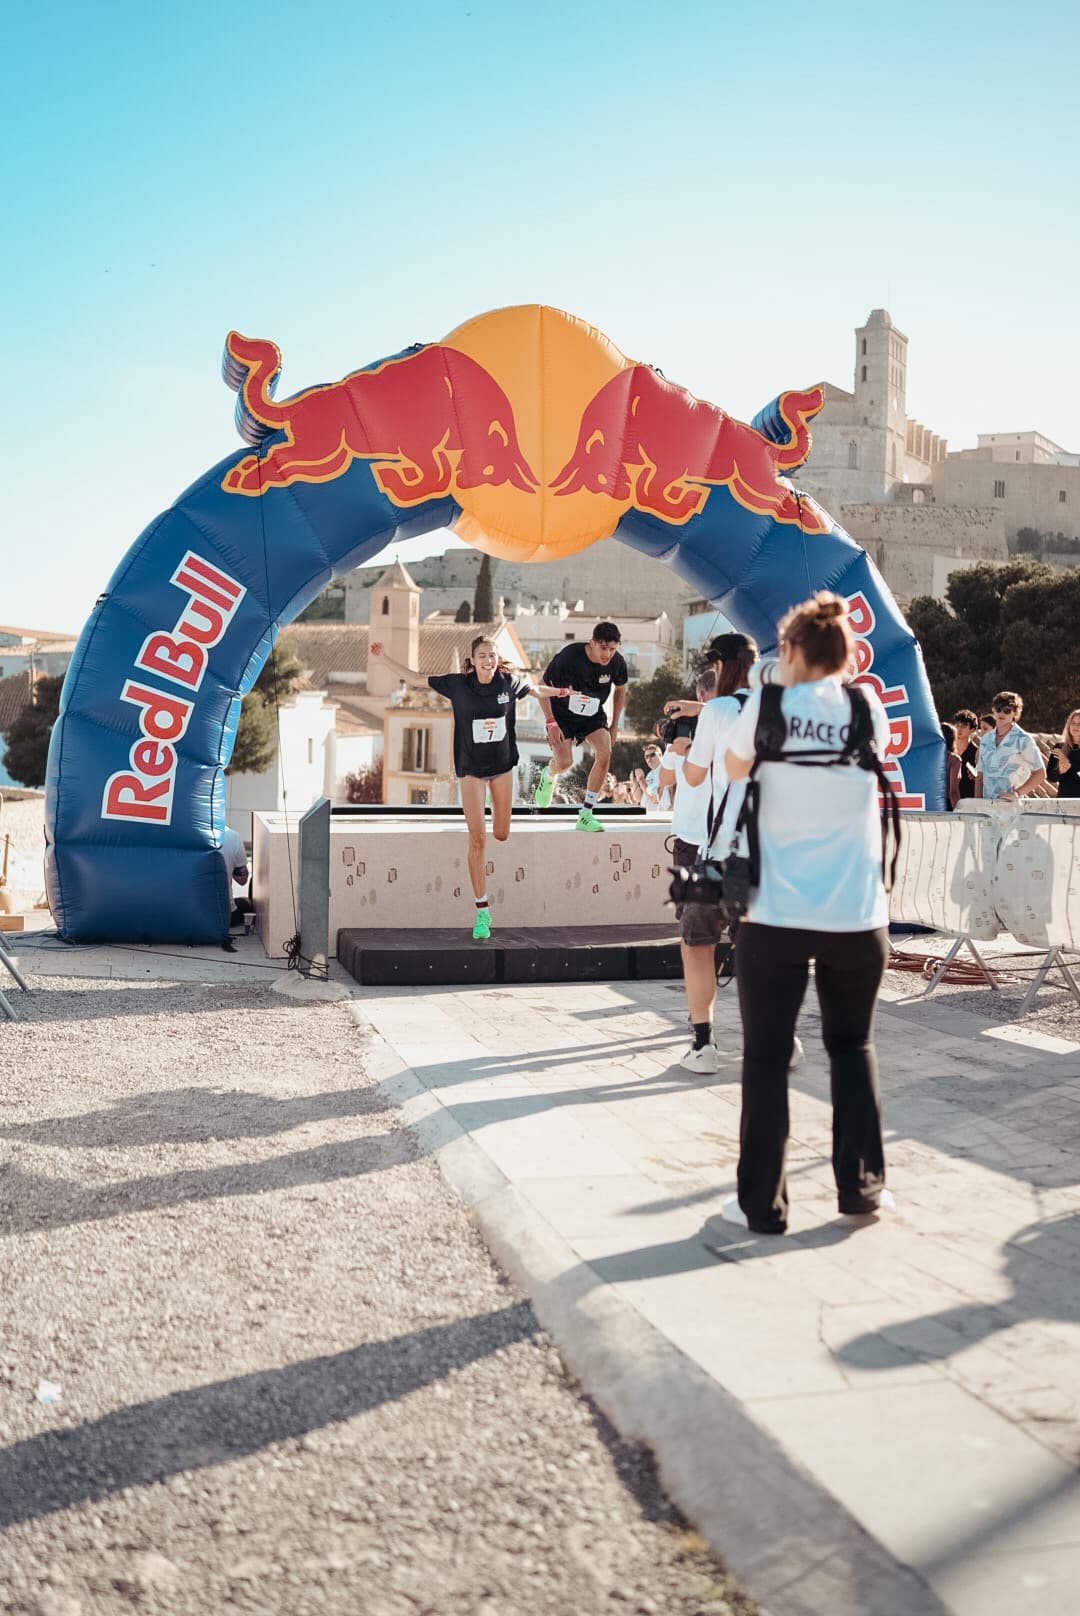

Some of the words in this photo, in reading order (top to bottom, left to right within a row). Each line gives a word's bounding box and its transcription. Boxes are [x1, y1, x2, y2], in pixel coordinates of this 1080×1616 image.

[135, 551, 246, 691] Bull
[581, 703, 586, 713] 7
[487, 729, 494, 741] 7
[790, 716, 835, 744] RACE
[102, 680, 194, 825] Red
